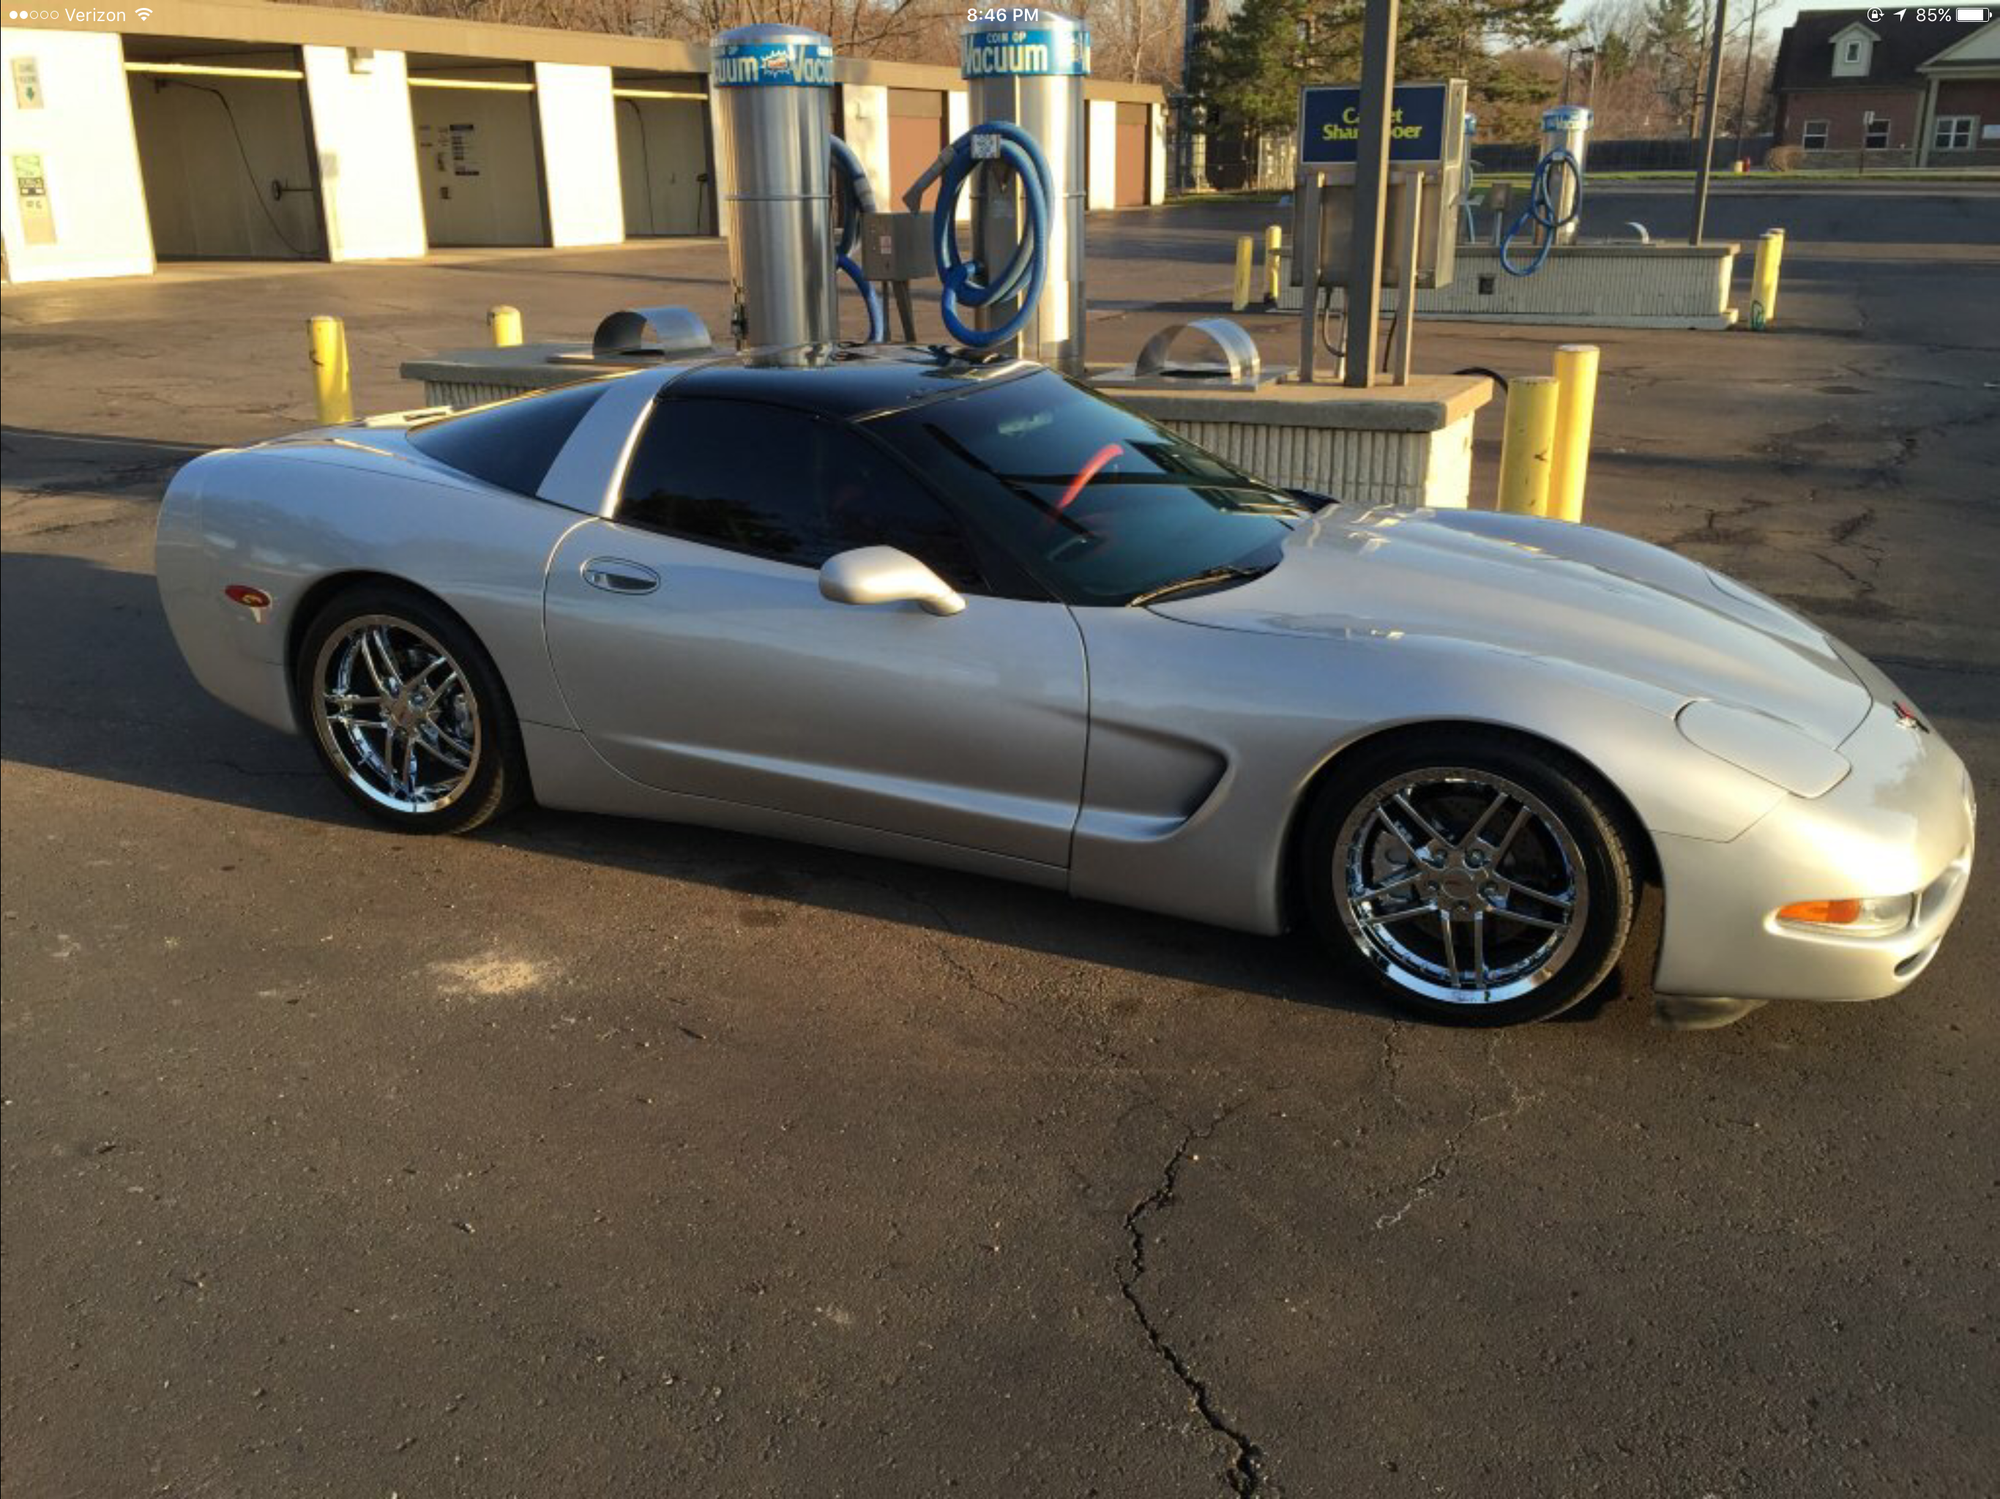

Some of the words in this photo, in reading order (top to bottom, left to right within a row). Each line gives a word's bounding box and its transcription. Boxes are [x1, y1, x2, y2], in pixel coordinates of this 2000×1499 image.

[1011, 31, 1027, 43] OP
[962, 34, 1048, 74] Vacuum
[1322, 124, 1422, 140] Shaoer
